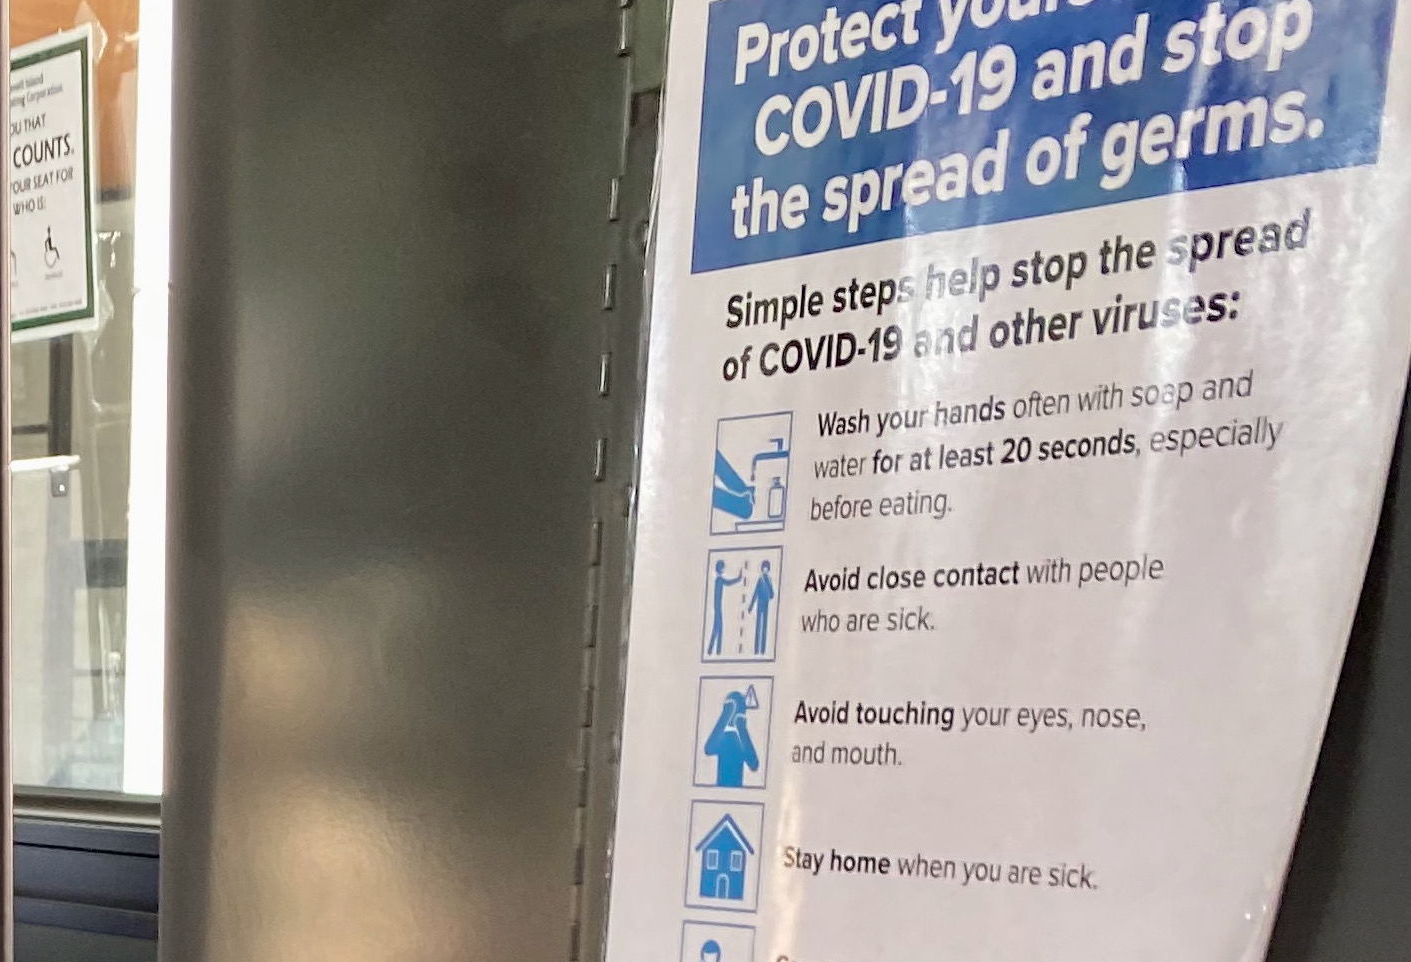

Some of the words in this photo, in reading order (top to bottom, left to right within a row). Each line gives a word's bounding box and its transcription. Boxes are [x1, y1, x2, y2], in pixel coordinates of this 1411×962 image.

[735, 0, 922, 85] Protect
[755, 44, 1017, 156] COVID-19
[1031, 12, 1150, 100] and
[1161, 0, 1313, 73] stop
[24, 113, 46, 131] THAT
[13, 132, 75, 169] COUNTS.
[732, 177, 810, 239] the
[822, 128, 1011, 233] spread
[1026, 112, 1093, 186] of
[1100, 90, 1325, 190] germs.
[10, 178, 31, 195] OUR
[33, 171, 54, 190] SEAT
[56, 166, 74, 184] FOR
[13, 199, 35, 215] WHO
[726, 284, 824, 330] Simple
[833, 276, 915, 316] steps
[926, 256, 1000, 302] help
[1012, 250, 1087, 290] stop
[1100, 235, 1156, 275] the
[1167, 208, 1312, 273] spread
[723, 346, 752, 381] of
[759, 325, 902, 376] COVID-19
[914, 314, 979, 357] and
[990, 307, 1083, 349] other
[1092, 291, 1241, 335] viruses:
[818, 408, 870, 437] Wash
[876, 407, 929, 438] your
[933, 395, 1006, 427] hands
[1013, 390, 1070, 418] often
[1077, 381, 1123, 412] with
[1131, 381, 1193, 411] soap
[1202, 368, 1254, 401] and
[814, 453, 868, 480] water
[872, 448, 903, 474] for
[909, 445, 933, 472] at
[939, 441, 994, 469] least
[1001, 436, 1032, 464] 20
[1038, 427, 1140, 461] seconds,
[1150, 416, 1284, 457] especially
[810, 494, 873, 521] before
[879, 489, 953, 520] eating.
[804, 566, 860, 593] Avoid
[866, 565, 926, 590] close
[933, 561, 1020, 587] contact
[1026, 557, 1071, 584] with
[1078, 553, 1164, 588] people
[801, 608, 840, 633] who
[846, 611, 880, 633] are
[886, 605, 936, 632] sick.
[794, 700, 849, 725] Avoid
[856, 700, 955, 732] touching
[960, 706, 1011, 732] your
[1016, 707, 1073, 734] eyes,
[1081, 708, 1146, 732] nose,
[791, 740, 825, 764] and
[831, 741, 903, 767] mouth.
[783, 846, 824, 876] Stay
[830, 849, 890, 875] home
[897, 853, 955, 880] when
[962, 861, 1001, 886] you
[1007, 866, 1041, 886] are
[1048, 862, 1099, 890] sick.
